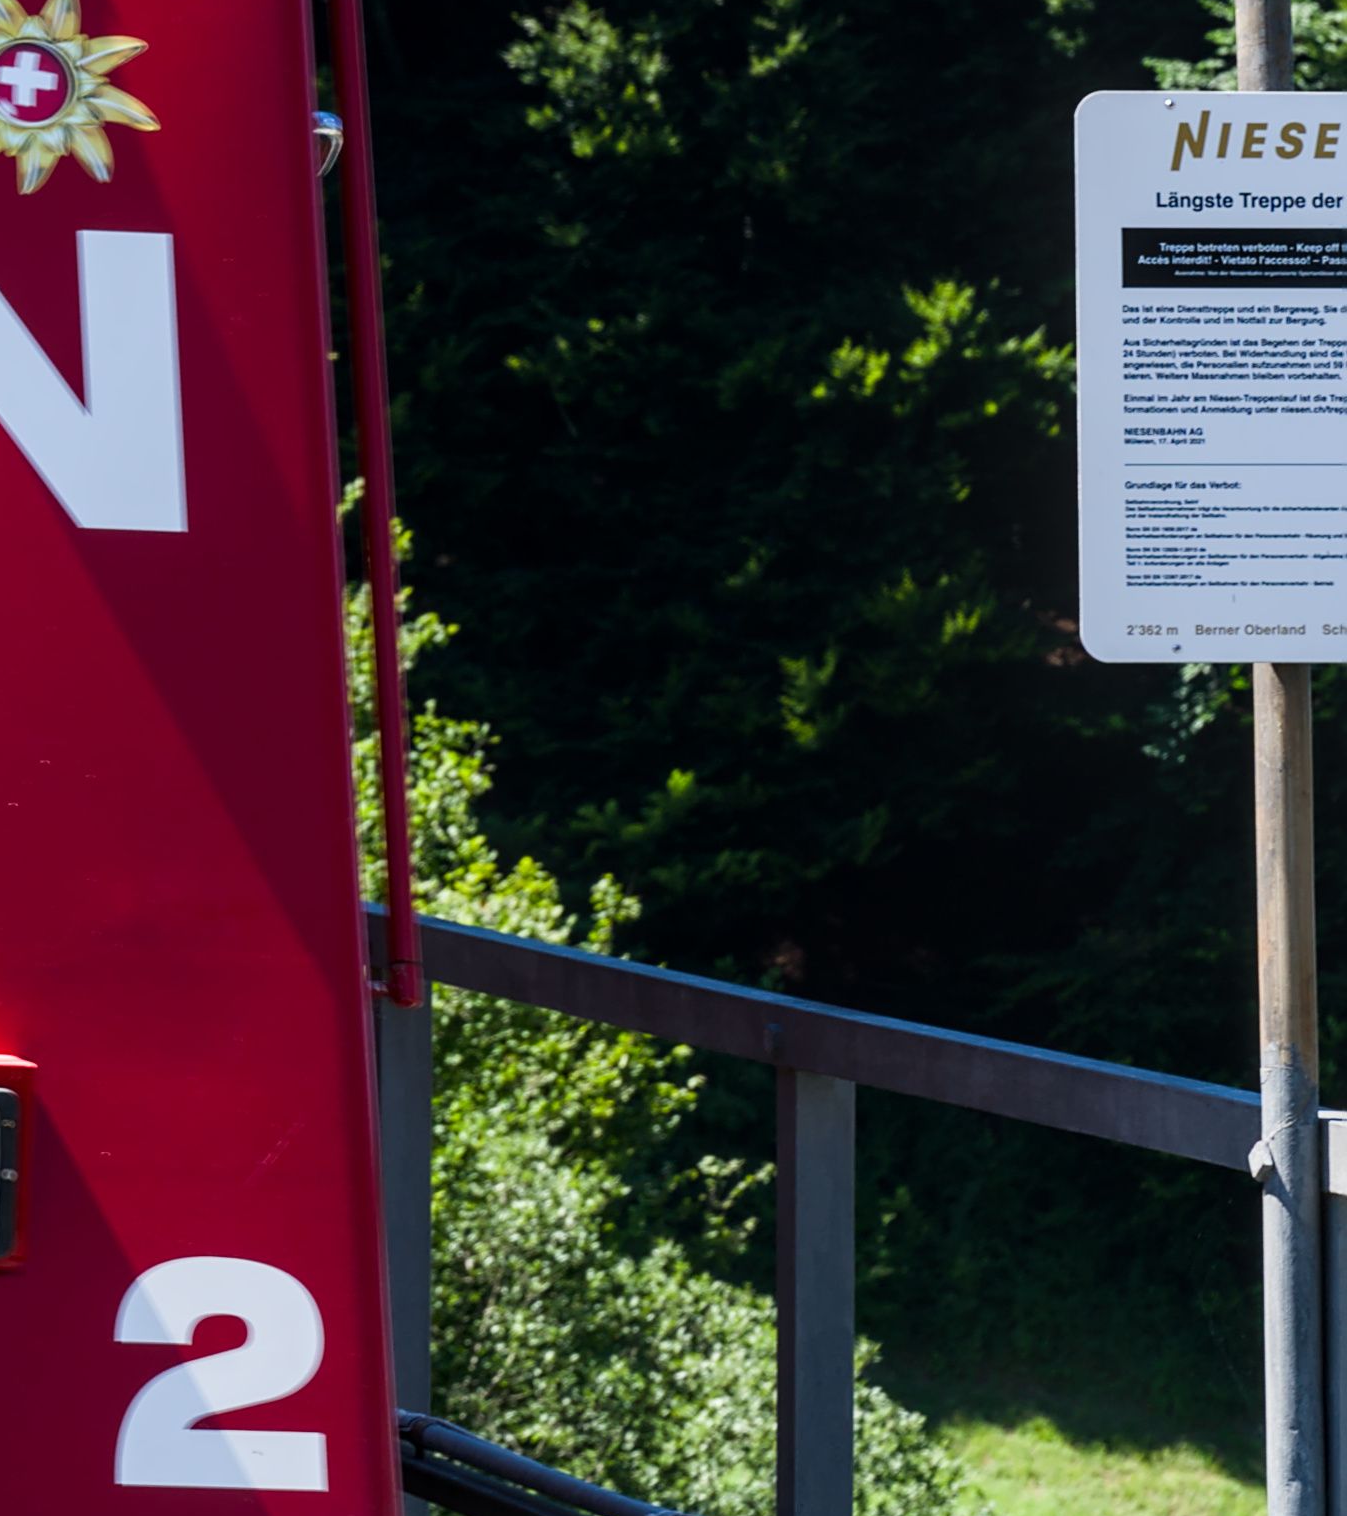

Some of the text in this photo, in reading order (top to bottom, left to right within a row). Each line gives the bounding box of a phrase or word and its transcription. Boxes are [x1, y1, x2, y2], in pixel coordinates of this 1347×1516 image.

[1156, 192, 1344, 212] Längste Treppe der
[1159, 242, 1195, 253] Treppe
[1196, 242, 1240, 253] betreten
[1242, 242, 1288, 253] verboten
[1296, 242, 1324, 253] Keep
[1325, 242, 1340, 253] off
[1137, 255, 1170, 265] Accès
[1171, 255, 1212, 265] interdit!
[1220, 255, 1258, 265] Vietato
[1122, 305, 1140, 315] Das
[1142, 305, 1154, 315] ist
[1155, 305, 1175, 315] eine
[1177, 305, 1235, 315] Diensttreppe
[1237, 305, 1255, 315] und
[1257, 305, 1271, 315] ein
[1323, 305, 1338, 315] Sie
[1122, 316, 1140, 324] und
[1142, 316, 1157, 324] der
[1160, 316, 1201, 324] Kontrolle
[1203, 316, 1221, 324] und
[1223, 316, 1235, 324] im
[1237, 316, 1266, 324] Notfall
[1268, 316, 1283, 324] zur
[1123, 338, 1141, 347] Aus
[1229, 338, 1241, 347] ist
[1242, 338, 1259, 347] das
[1261, 338, 1300, 348] Begehen
[1301, 338, 1316, 347] der
[1123, 349, 1134, 358] 24
[1221, 349, 1237, 358] Bei
[1309, 349, 1328, 358] sind
[1330, 349, 1345, 358] die
[1180, 361, 1194, 370] die
[1313, 361, 1331, 369] und
[1155, 372, 1189, 380] Weitere
[1191, 372, 1250, 380] Massnahmen
[1252, 372, 1285, 380] bleiben
[1123, 394, 1155, 402] Einmal
[1157, 394, 1169, 402] im
[1170, 394, 1191, 402] Jahr
[1193, 394, 1207, 402] am
[1299, 394, 1312, 402] ist
[1313, 394, 1327, 402] die
[1180, 405, 1198, 413] und
[1200, 405, 1253, 415] Anmeldung
[1255, 405, 1279, 413] unter
[1124, 427, 1204, 436] NIESENBAHN AG
[1124, 481, 1173, 491] Grundlage
[1174, 481, 1188, 490] für
[1190, 481, 1207, 490] das
[1126, 624, 1163, 636] 2'362
[1166, 627, 1179, 636] m
[1195, 624, 1240, 636] Berner
[1244, 624, 1307, 636] Oberland
[114, 1256, 329, 1492] 2
